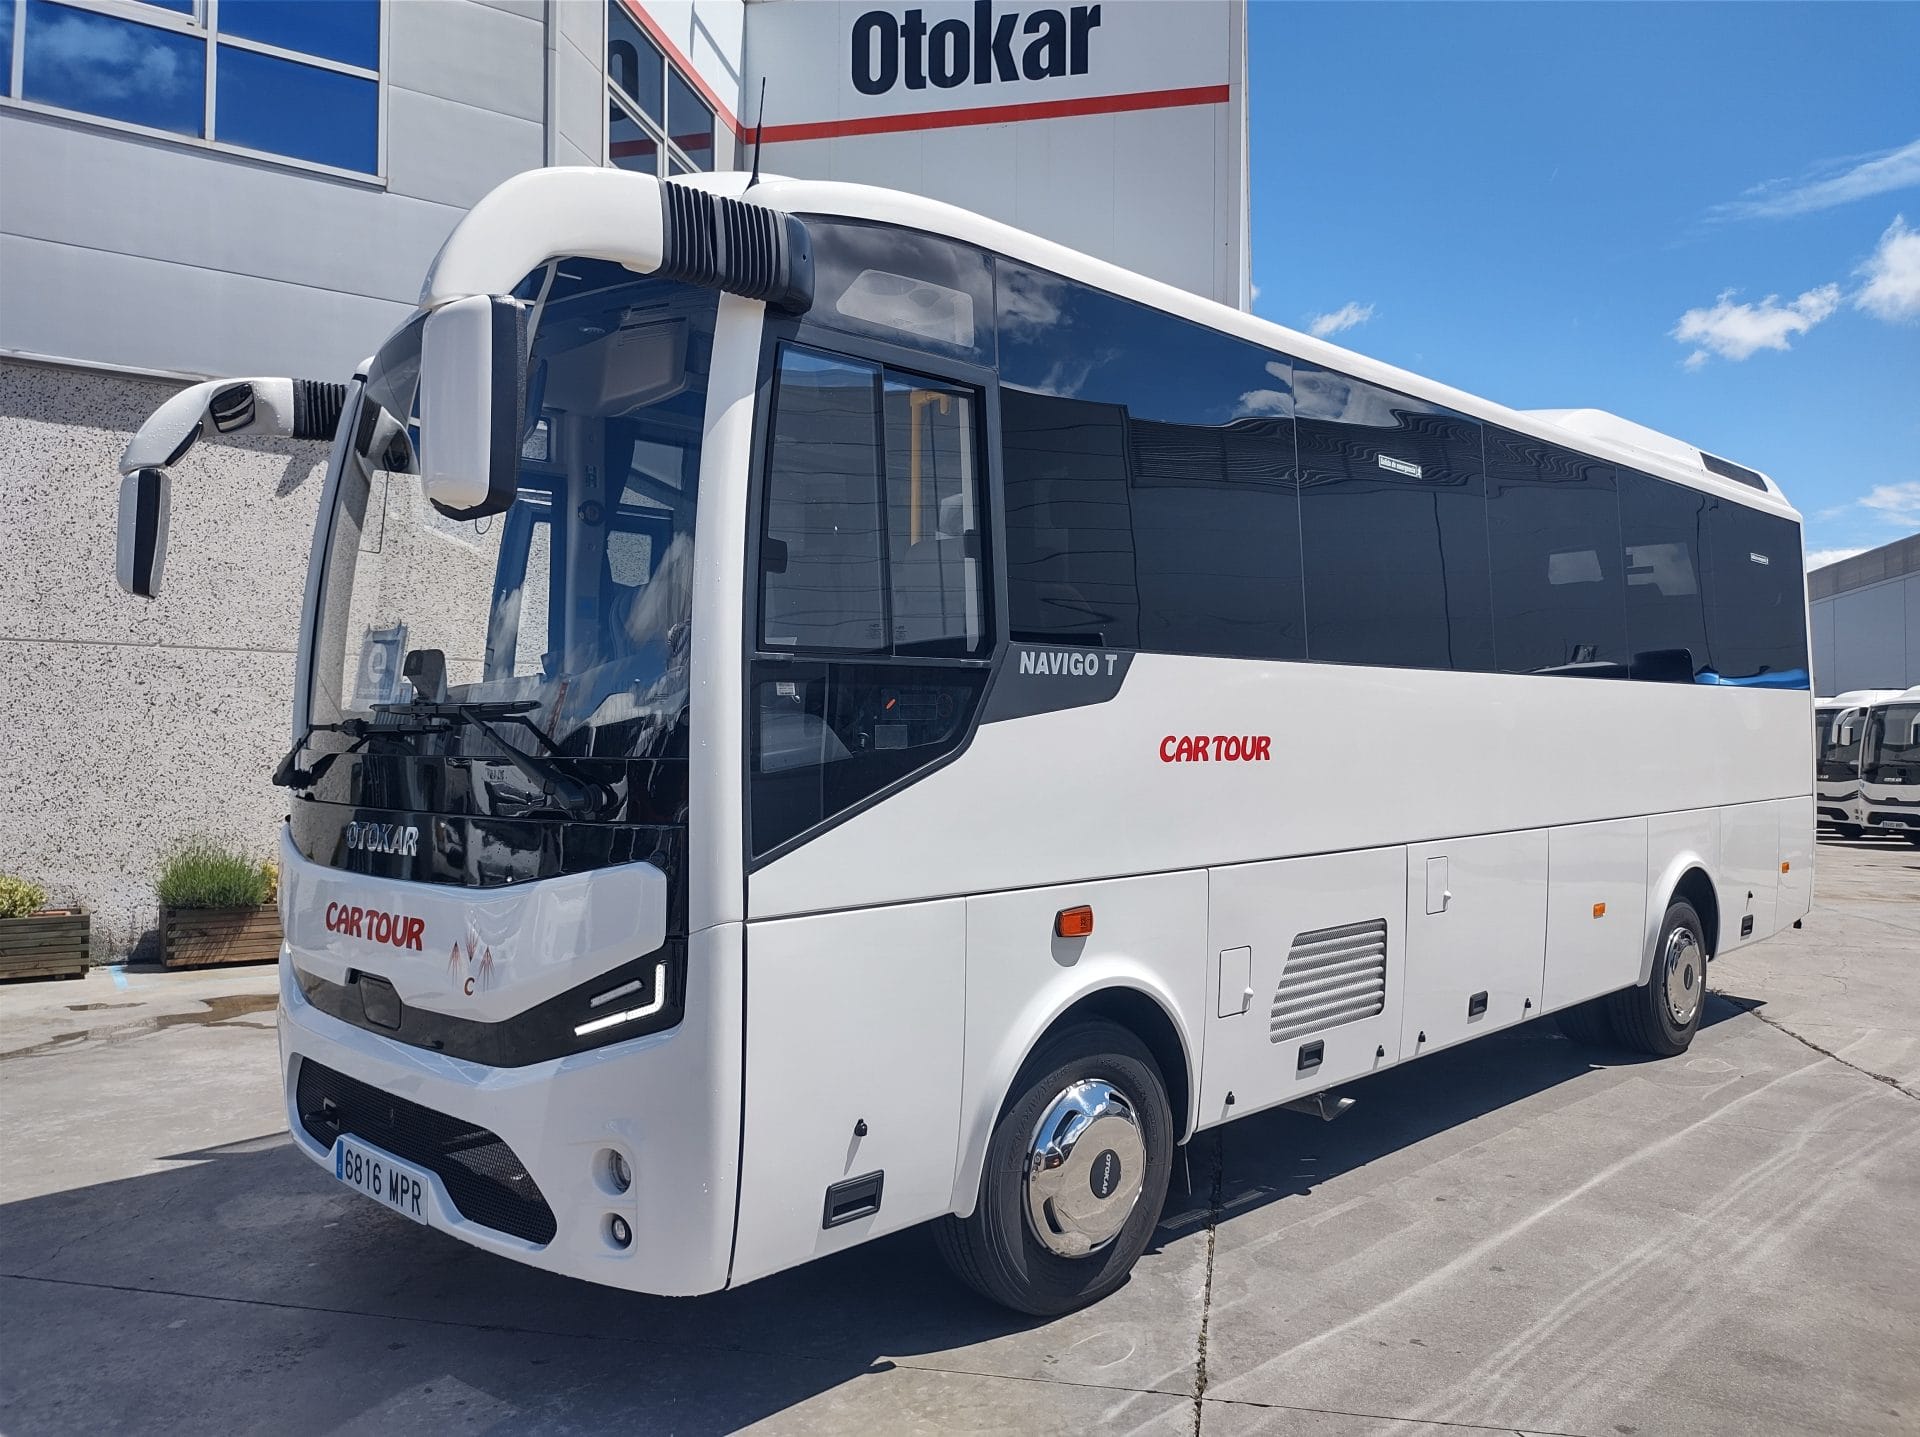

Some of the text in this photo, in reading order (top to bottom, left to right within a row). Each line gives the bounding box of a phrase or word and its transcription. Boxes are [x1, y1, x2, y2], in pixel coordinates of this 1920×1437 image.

[851, 0, 1101, 96] Otokar
[1019, 651, 1117, 676] NAVIGO T
[346, 821, 419, 857] OTOKAR
[345, 1149, 422, 1216] 6816 MPR
[1101, 1153, 1112, 1195] OTOKAR
